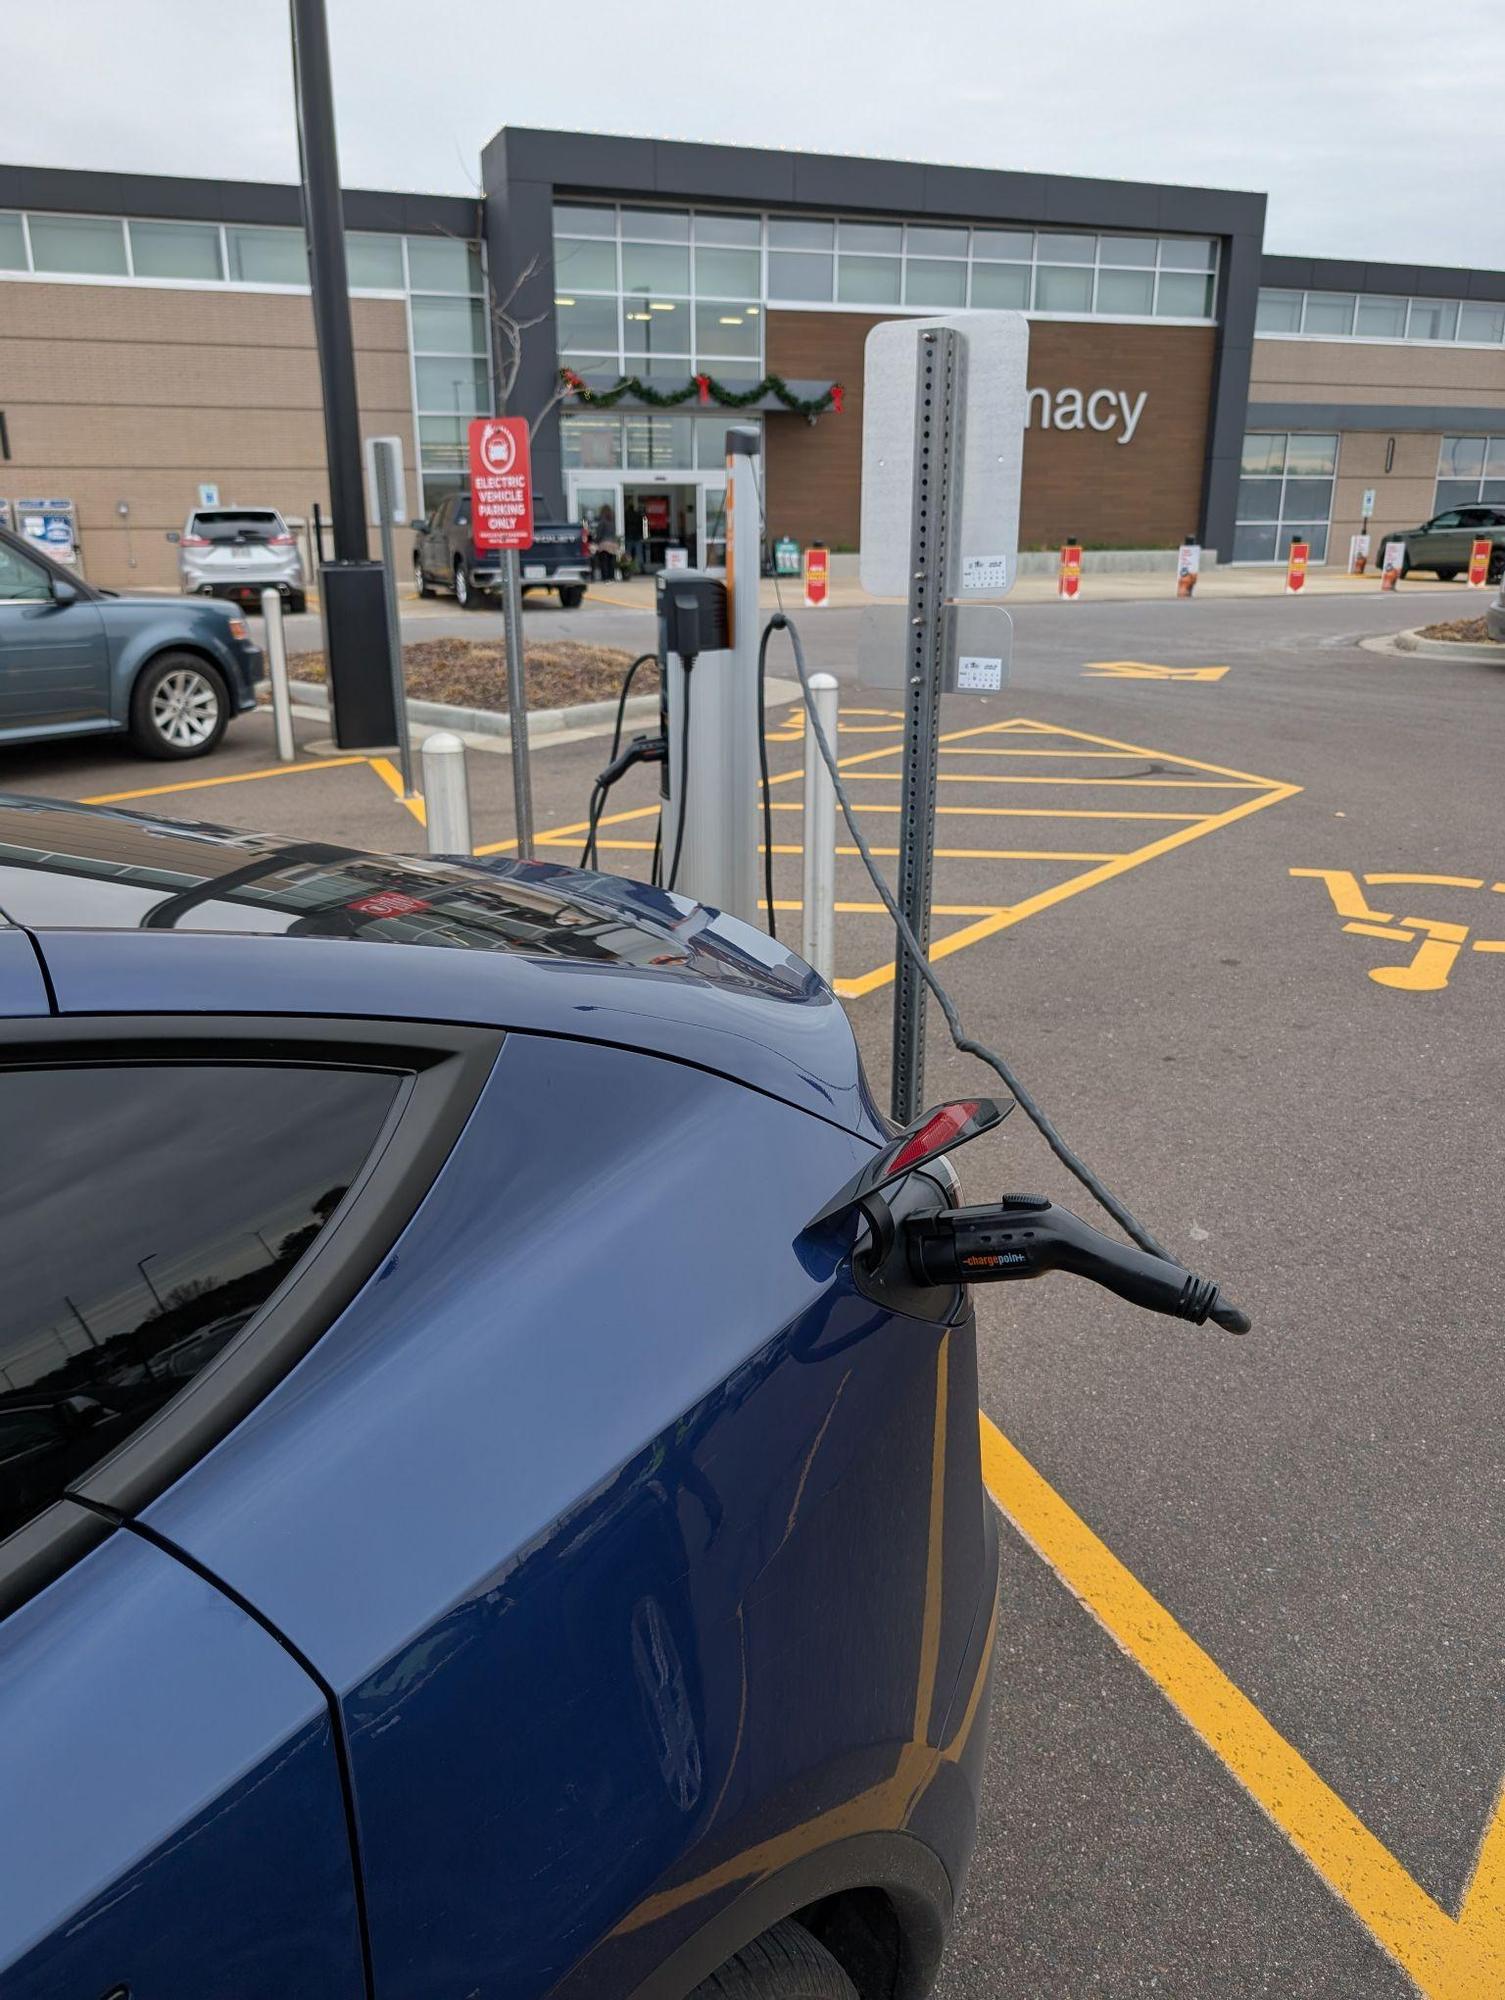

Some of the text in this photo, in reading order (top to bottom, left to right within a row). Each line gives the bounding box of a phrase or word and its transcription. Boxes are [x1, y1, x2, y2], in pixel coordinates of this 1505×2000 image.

[475, 475, 526, 489] ELECTRIC
[478, 489, 524, 502] VEHICLE
[478, 503, 526, 516] PARKING
[488, 517, 517, 529] ONLY
